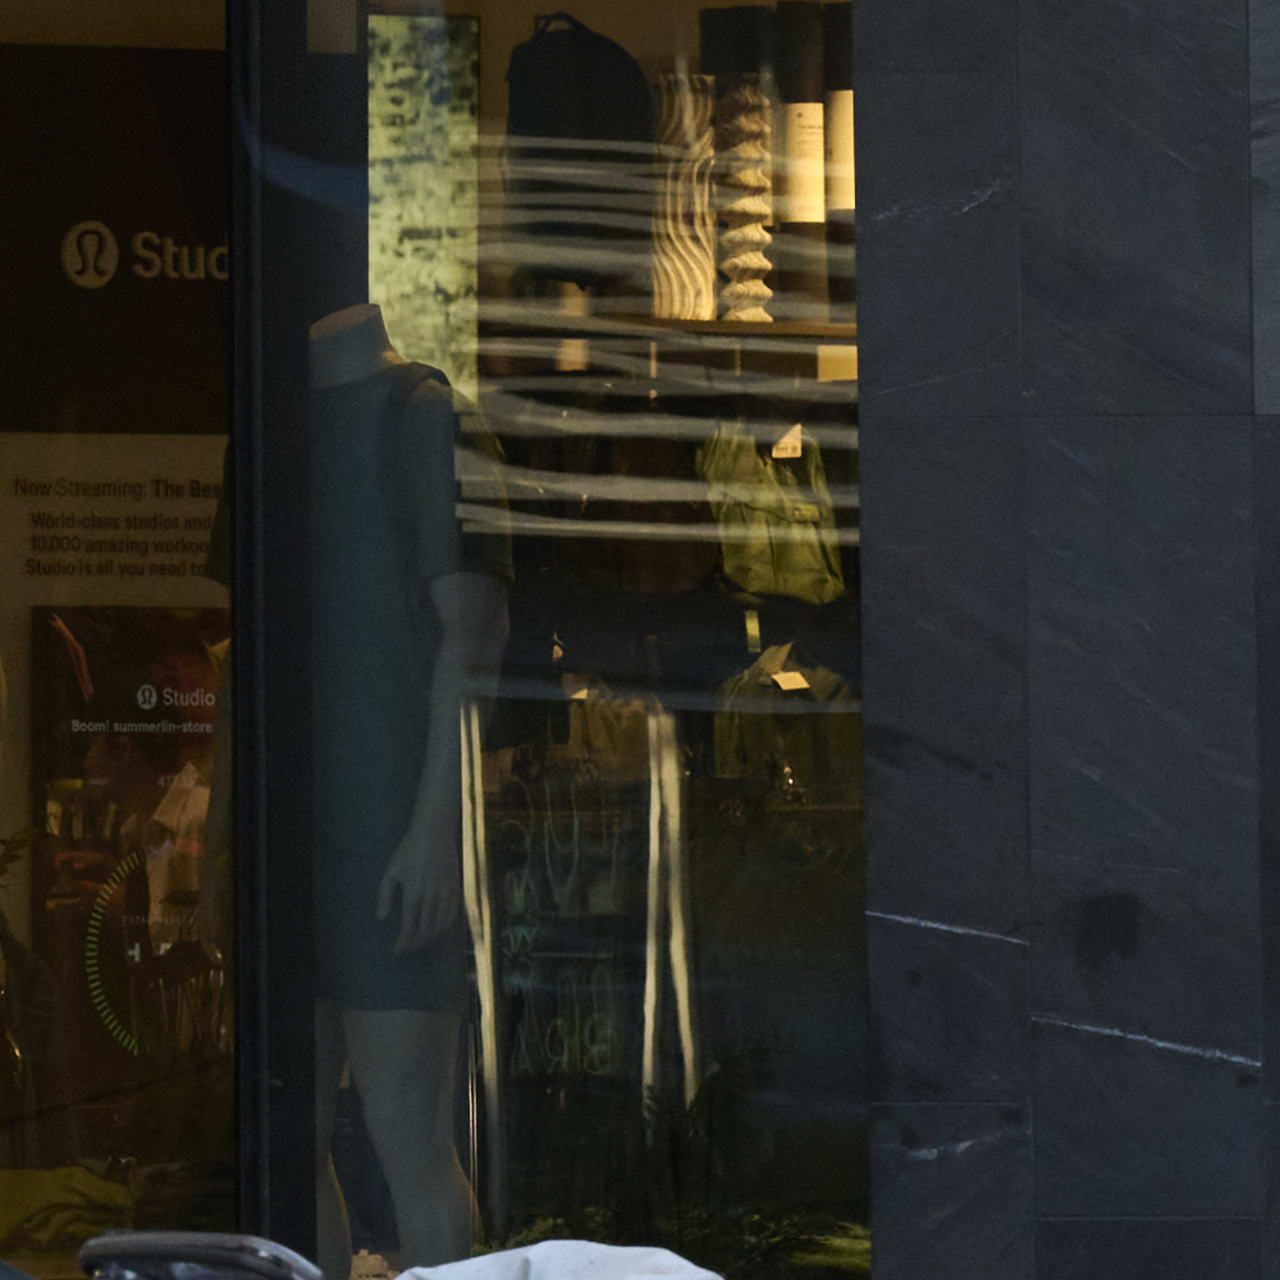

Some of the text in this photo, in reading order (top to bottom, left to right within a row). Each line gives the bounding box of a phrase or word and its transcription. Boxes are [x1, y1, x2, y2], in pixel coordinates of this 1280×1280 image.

[153, 479, 185, 497] The
[163, 687, 216, 707] Studio
[72, 719, 213, 734] Boom! summerlin-store
